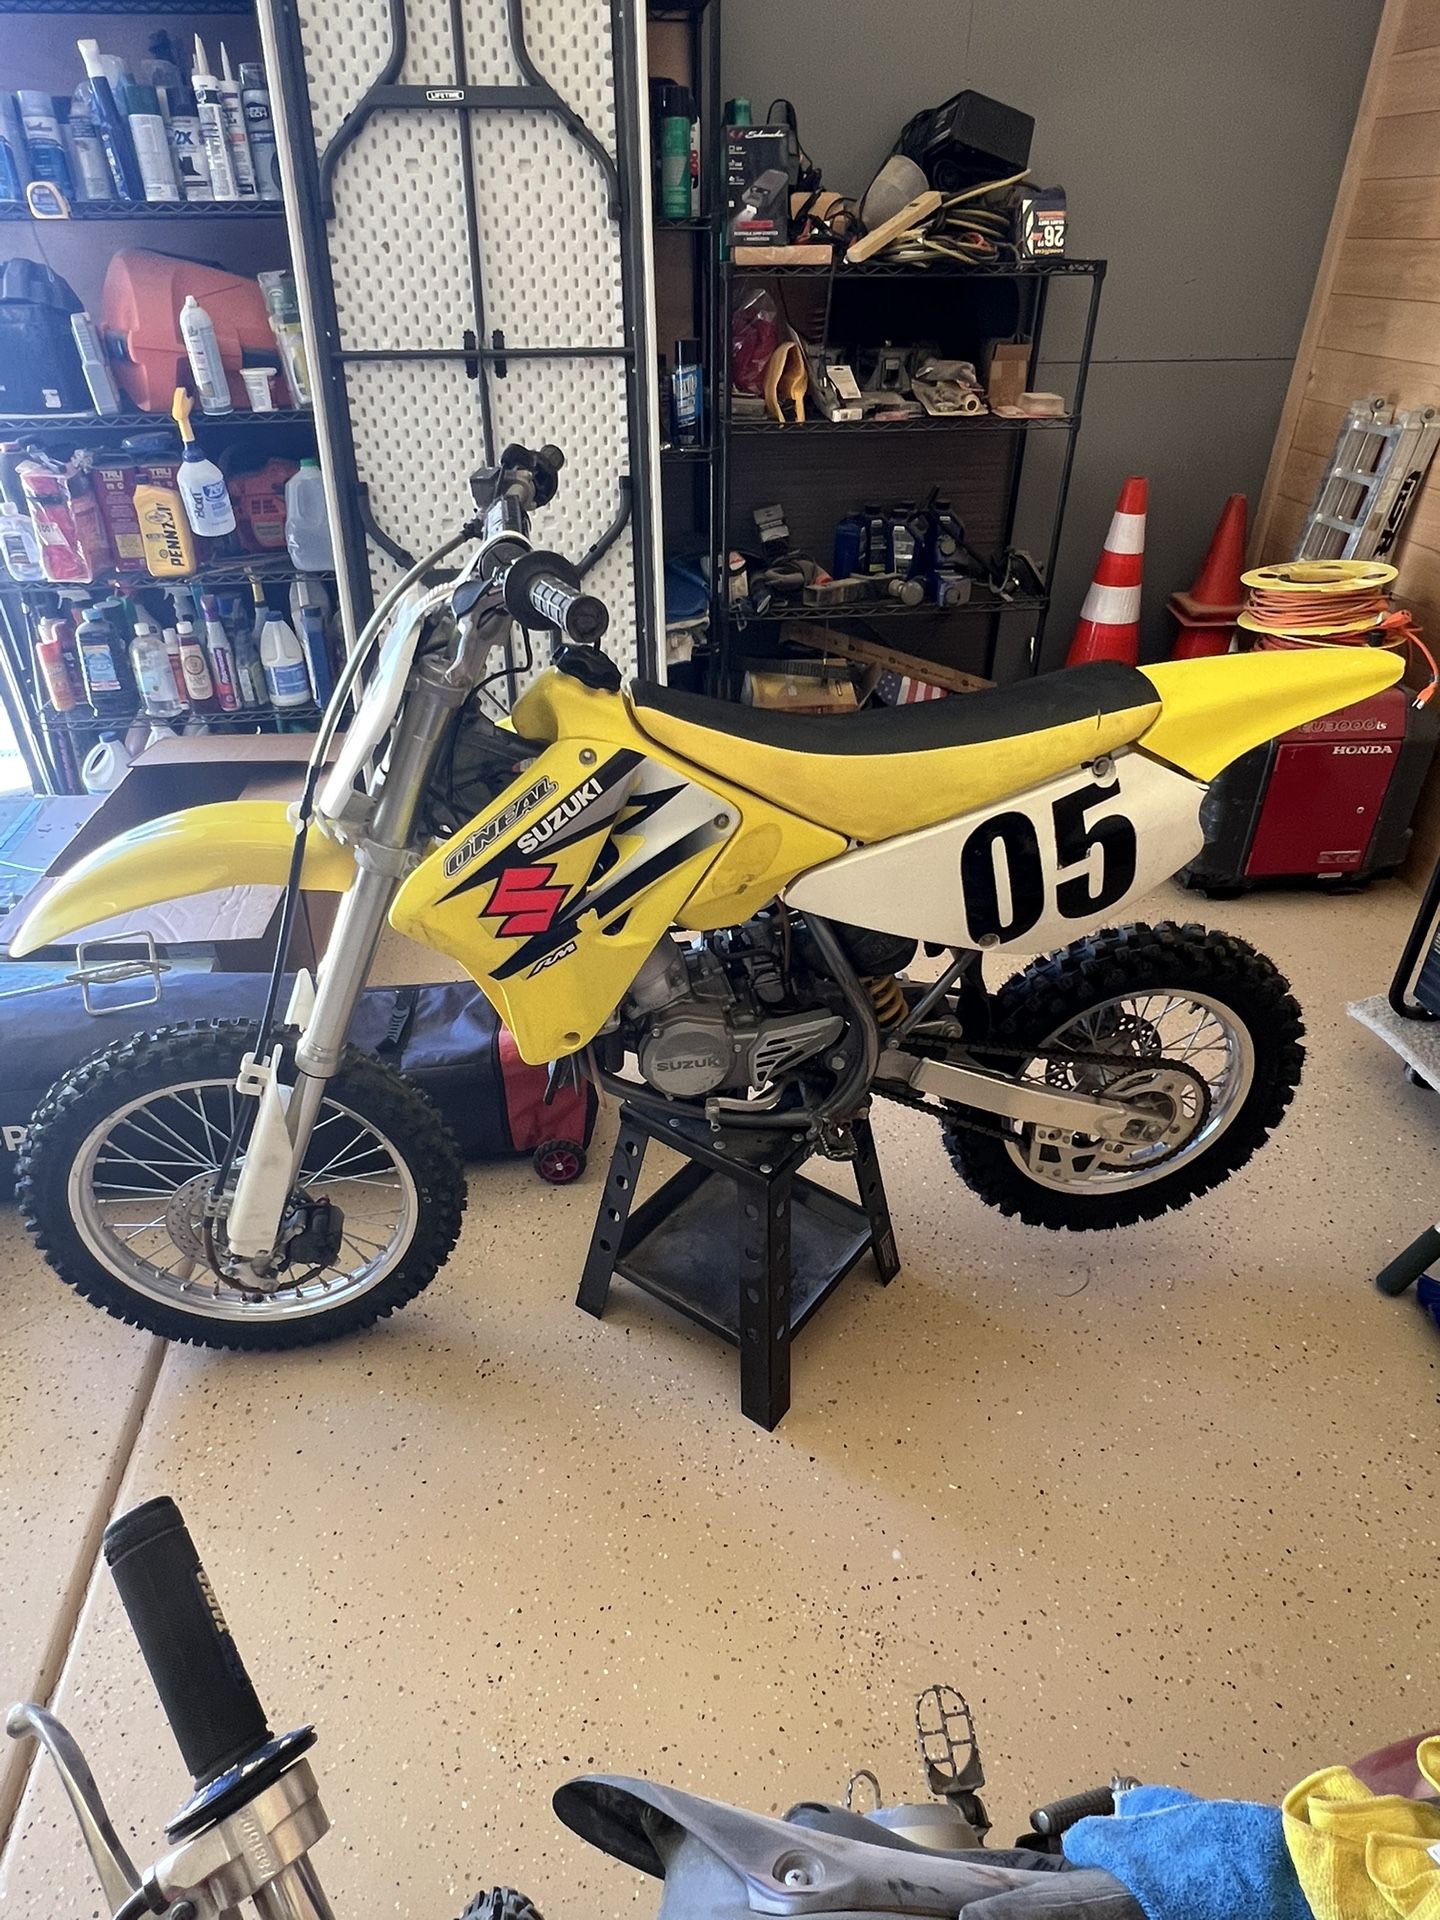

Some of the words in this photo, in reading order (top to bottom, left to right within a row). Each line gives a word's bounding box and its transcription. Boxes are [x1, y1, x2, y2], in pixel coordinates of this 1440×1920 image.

[1332, 745, 1392, 755] HONDA
[517, 777, 604, 855] SUZUKI
[960, 777, 1137, 945] 05
[656, 1055, 722, 1071] SUZUK
